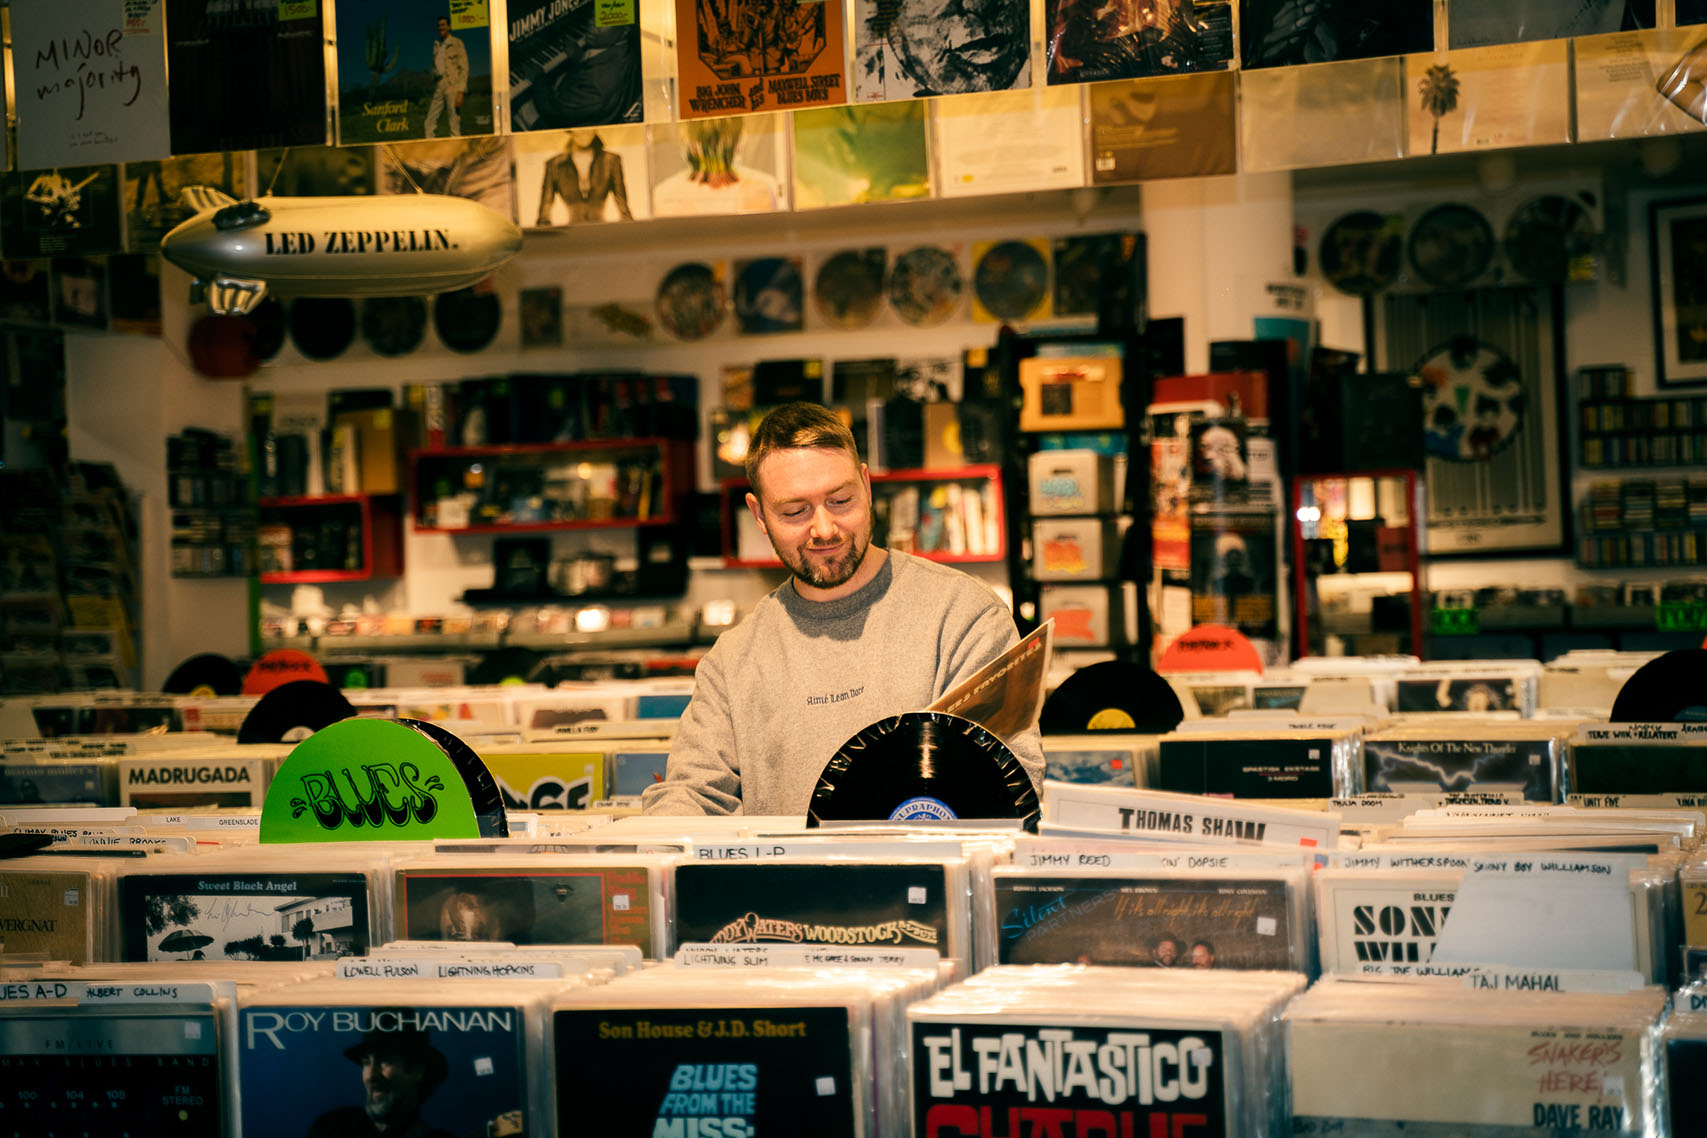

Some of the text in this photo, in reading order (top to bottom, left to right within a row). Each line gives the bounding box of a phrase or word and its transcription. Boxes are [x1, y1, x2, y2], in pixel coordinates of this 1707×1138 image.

[509, 6, 547, 41] JIMMY
[36, 29, 122, 70] MINOR
[37, 61, 141, 120] majority
[715, 82, 741, 96] JOHN
[768, 77, 807, 94] MAXWELL
[810, 74, 841, 89] STREET
[362, 99, 408, 116] Sanford
[376, 117, 409, 133] Clark
[265, 229, 459, 255] LED ZEPPELIN.
[1430, 742, 1443, 753] Of
[1446, 743, 1463, 753] The
[1464, 742, 1483, 753] New
[128, 767, 251, 785] MADRUGADA
[301, 762, 438, 830] BLUES
[219, 818, 259, 826] GREENSLADE
[1118, 807, 1266, 842] THOMAS SHAW
[699, 847, 749, 859] BLUES
[1030, 855, 1110, 866] JIMMY REED
[1188, 857, 1229, 868] DOPSIE
[1345, 857, 1380, 868] JIMMY
[1541, 863, 1612, 874] WILLIAMSON
[198, 881, 297, 893] Sweet Black Angel
[1413, 892, 1455, 902] BLUES
[1001, 896, 1067, 939] Silent
[802, 921, 902, 944] WOODSTOCK
[683, 954, 768, 967] LIGHTNING SLIM
[1354, 941, 1437, 963] WIL
[343, 964, 381, 977] LOWELL
[438, 963, 535, 978] LIGHTNING HOPKINS
[35, 984, 67, 999] A-D
[86, 987, 123, 999] ALBERT
[133, 987, 178, 999] COLLINS
[1505, 974, 1565, 992] MAHAL
[246, 1011, 511, 1050] ROY BUCHANAN
[599, 1020, 806, 1039] Son House & J.D. Short
[923, 1027, 1210, 1106] EL FANTASTICO
[669, 1063, 758, 1091] BLUES
[18, 1090, 38, 1100] 100
[65, 1090, 85, 1100] 104
[162, 1095, 204, 1105] STEREO
[658, 1093, 756, 1115] FROM THE
[1533, 1102, 1624, 1130] DAVE RAY
